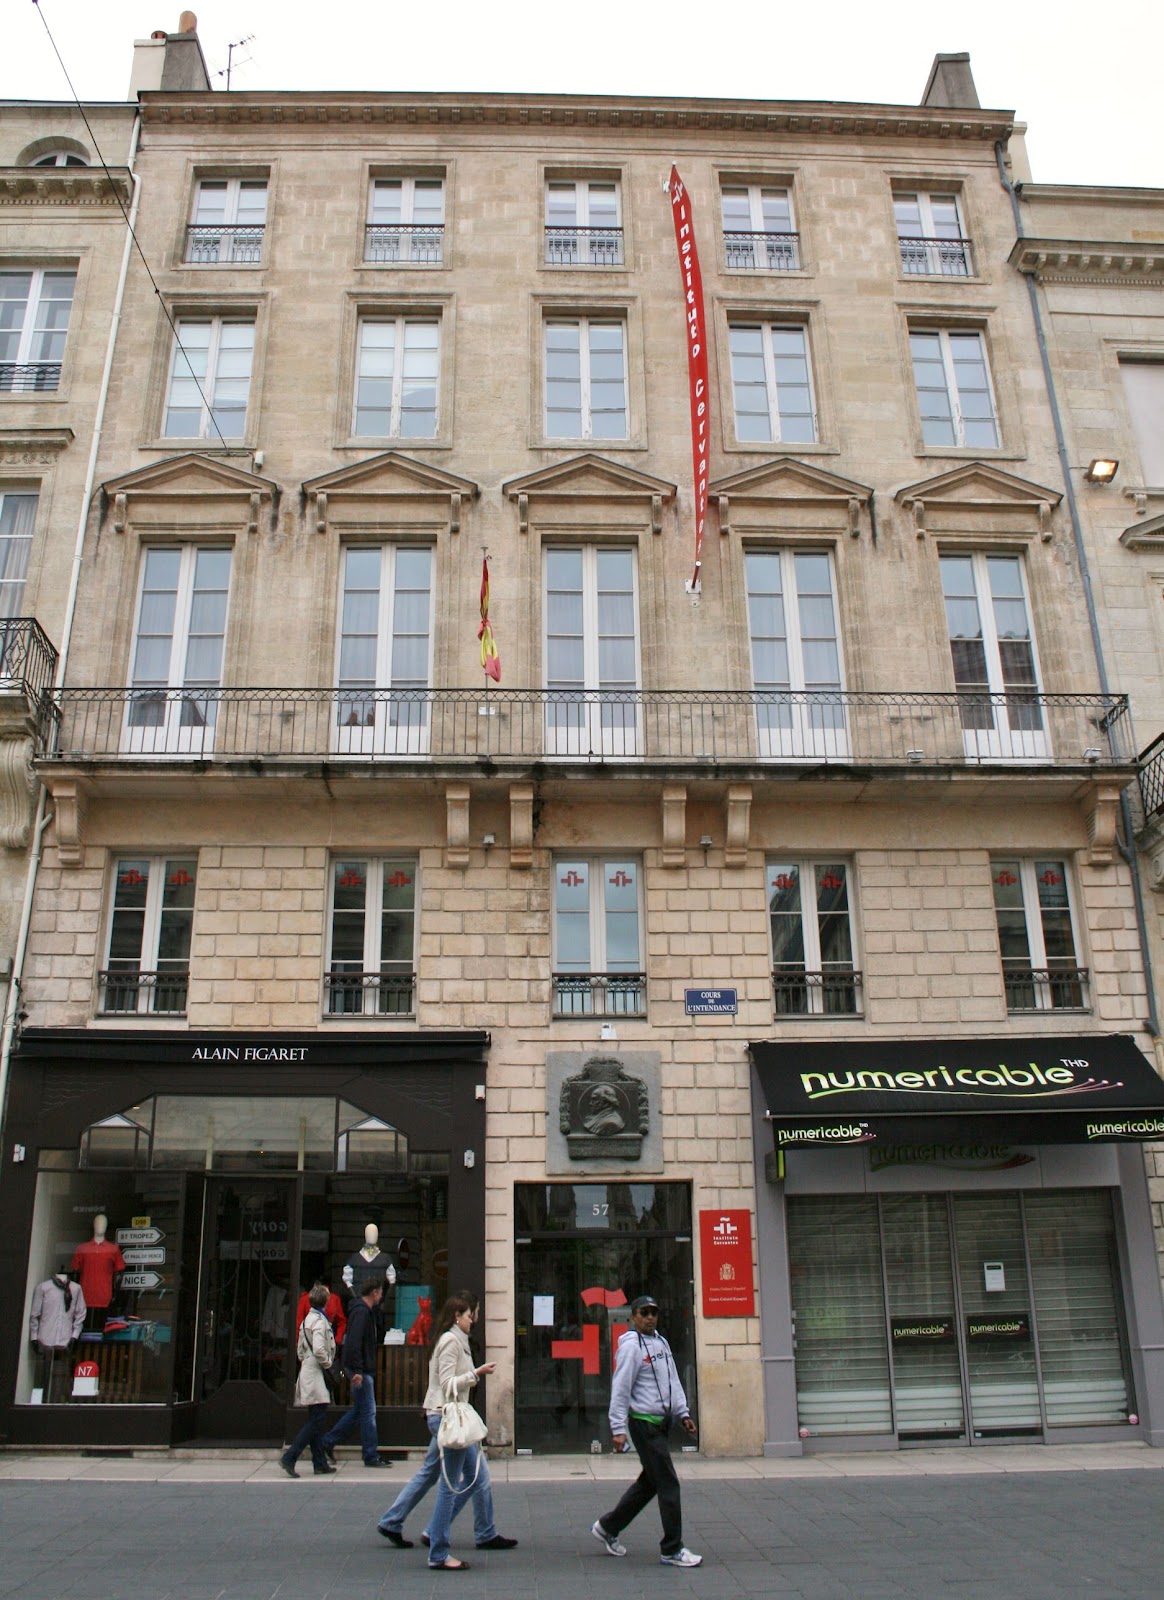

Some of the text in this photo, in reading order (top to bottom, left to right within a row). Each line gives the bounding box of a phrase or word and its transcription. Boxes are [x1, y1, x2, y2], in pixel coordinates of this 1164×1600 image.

[680, 205, 707, 554] Instituto Cervantes
[192, 1047, 309, 1060] ALAIN FIGARET
[800, 1058, 1089, 1092] numericable THD
[778, 1124, 862, 1141] numericable
[1086, 1119, 1164, 1136] numericable
[592, 1204, 609, 1216] 57
[130, 1232, 154, 1240] TROPEZ
[124, 1276, 146, 1285] NICE
[893, 1325, 945, 1336] numericable
[970, 1323, 1020, 1332] numericable
[77, 1366, 93, 1377] N7
